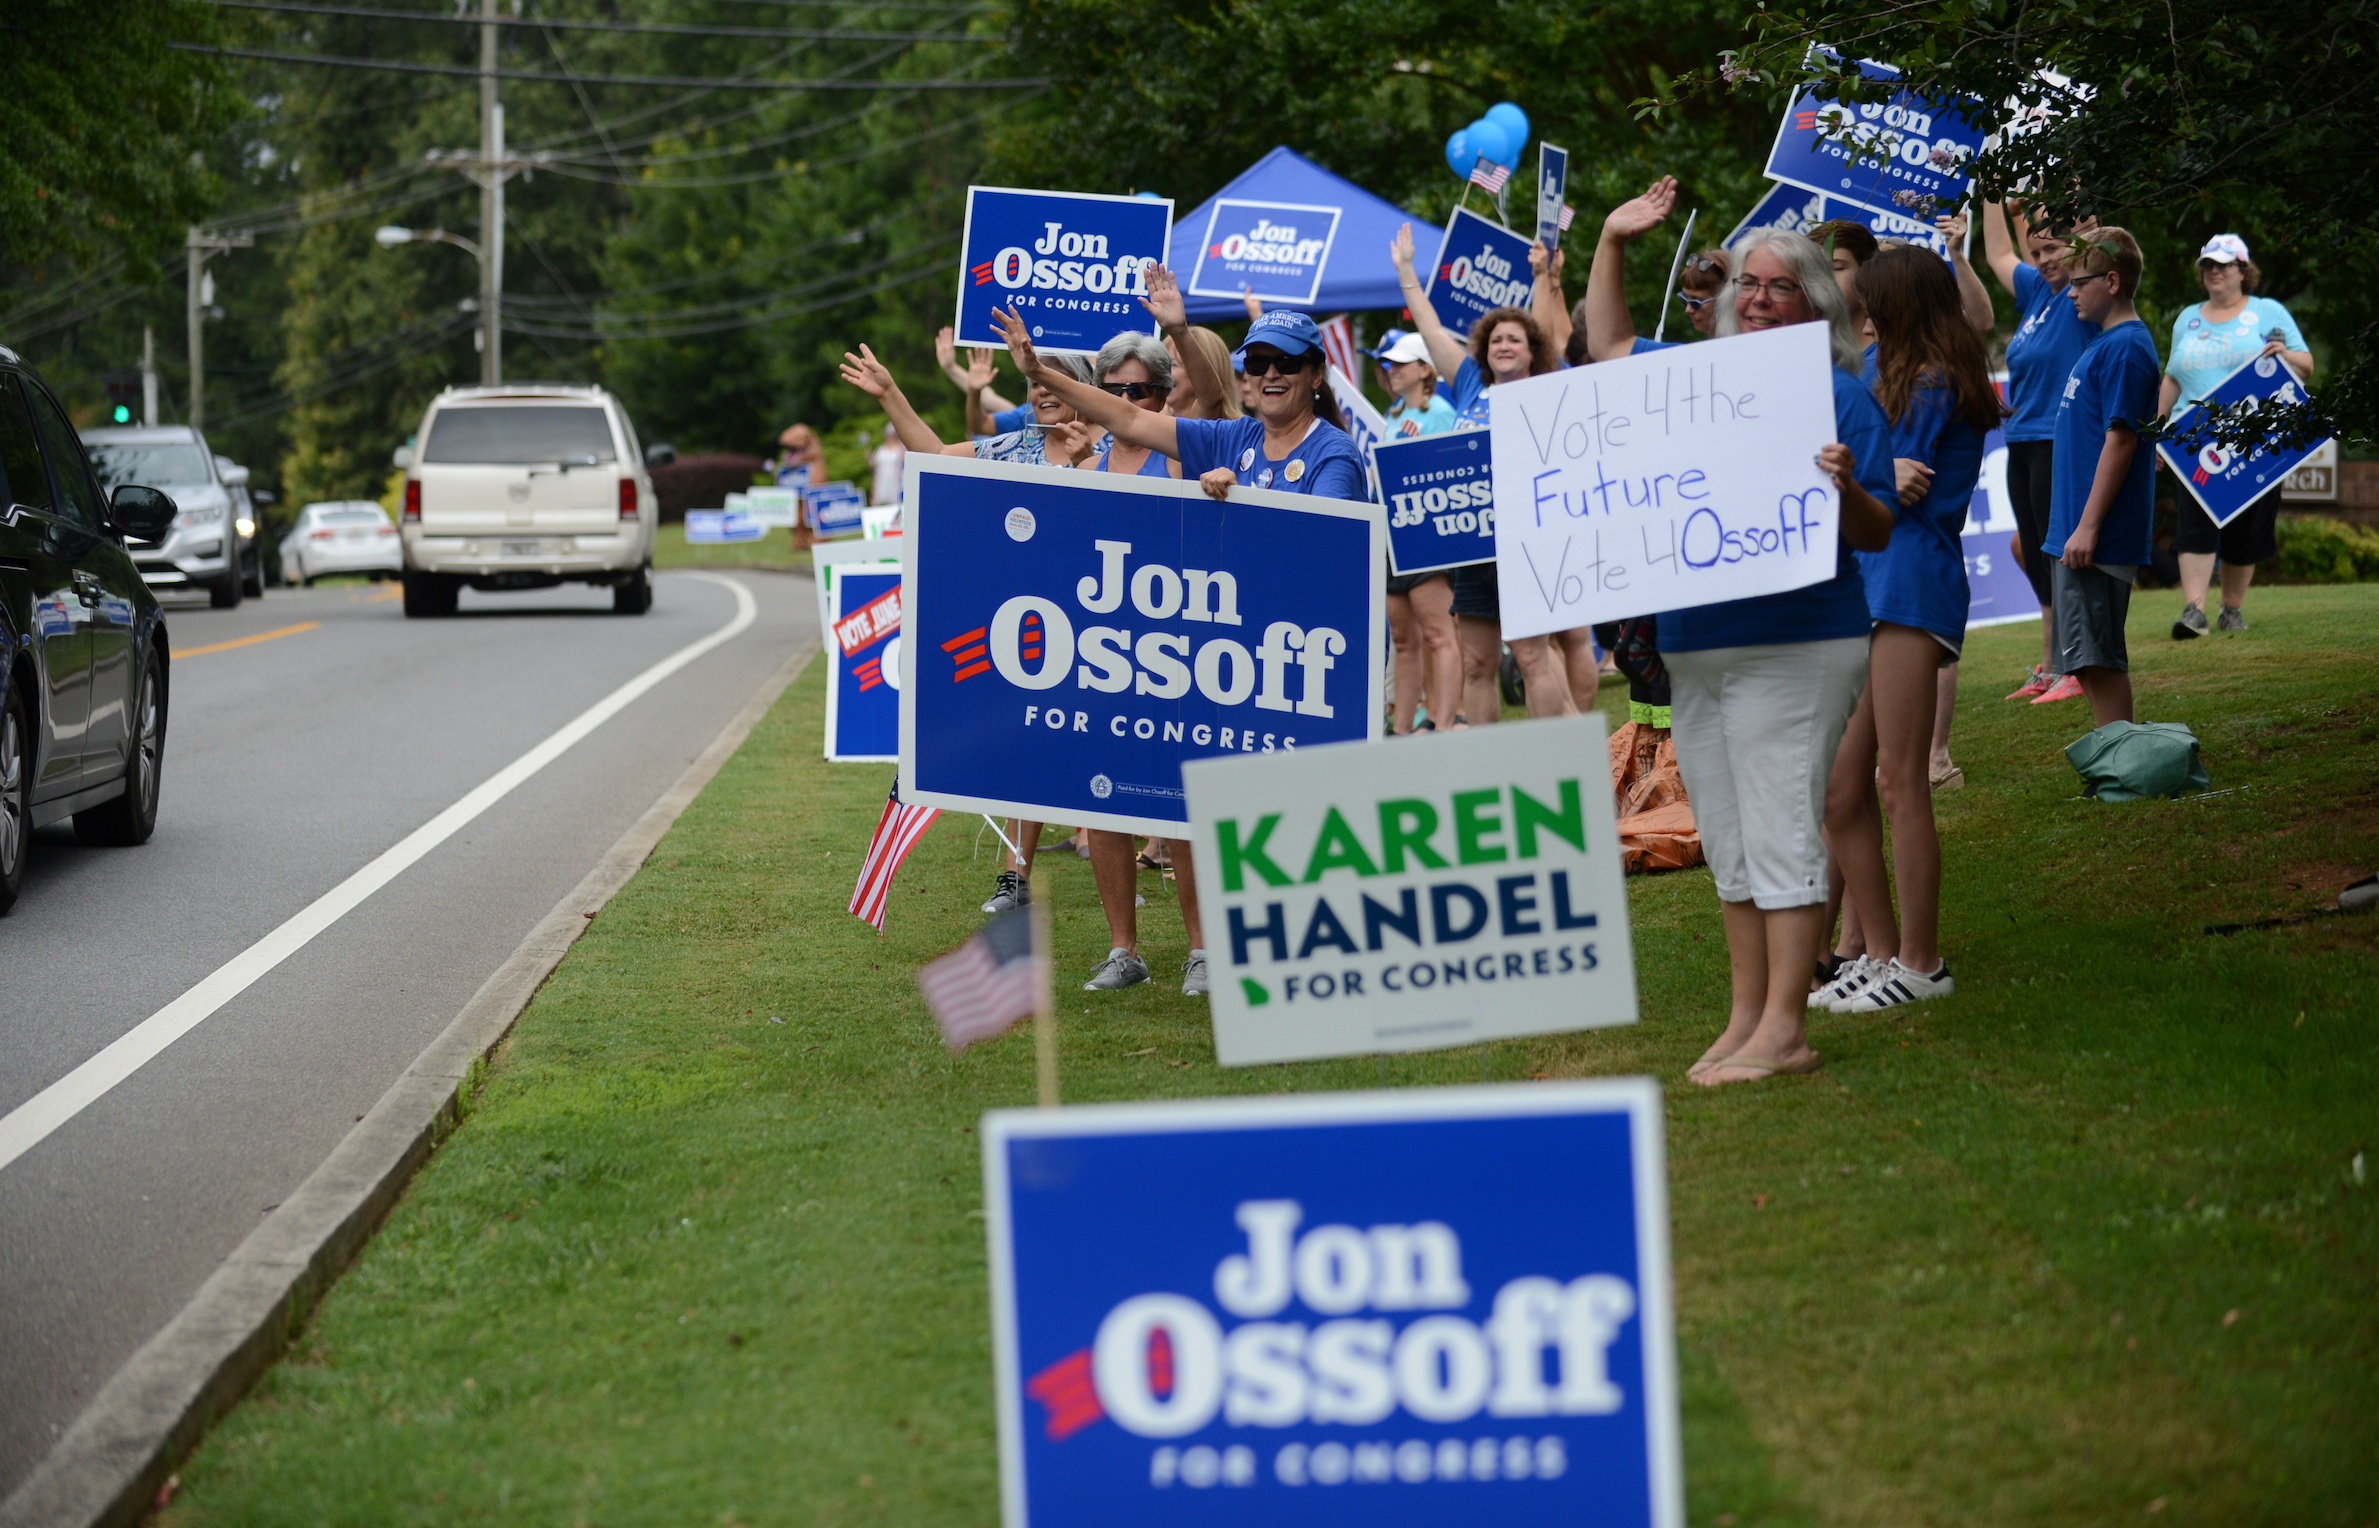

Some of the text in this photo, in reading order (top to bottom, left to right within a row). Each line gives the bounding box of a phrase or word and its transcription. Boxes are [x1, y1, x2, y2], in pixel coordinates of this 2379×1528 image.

[1860, 98, 1932, 138] Jon
[1821, 144, 1940, 190] FOR CONGRESS
[1034, 222, 1109, 259] Jon
[1221, 233, 1324, 266] Ossoff
[1249, 219, 1297, 243] Jon
[993, 246, 1157, 296] Ossoff
[1225, 261, 1303, 277] FOR CONGRESS
[1449, 256, 1530, 308] Ossoff
[1474, 244, 1512, 281] Jon
[1006, 294, 1130, 315] FOR CONGRESS
[1269, 319, 1294, 330] AGAIN
[1270, 312, 1303, 327] AMERICA
[1450, 290, 1492, 315] FOR CONG
[1519, 380, 1631, 466] Vote
[1402, 466, 1475, 486] CONGRESS
[1532, 460, 1711, 528] Future
[2224, 462, 2247, 481] FOR
[1391, 479, 1493, 529] ssoff
[1432, 508, 1495, 538] Jon
[1076, 539, 1242, 626] Jon
[1520, 528, 1630, 613] Vote
[837, 592, 901, 651] VOTE JUNE
[989, 595, 1347, 719] Ossoff
[1024, 706, 1296, 754] FOR CONGRESS
[1214, 776, 1588, 893] KAREN
[1226, 869, 1598, 967] HANDEL
[1284, 943, 1599, 1002] FOR CONGRESS
[1212, 1198, 1471, 1318] Jon
[1090, 1272, 1637, 1439] Ossoff
[1149, 1434, 1568, 1489] FOR CONGRESS
